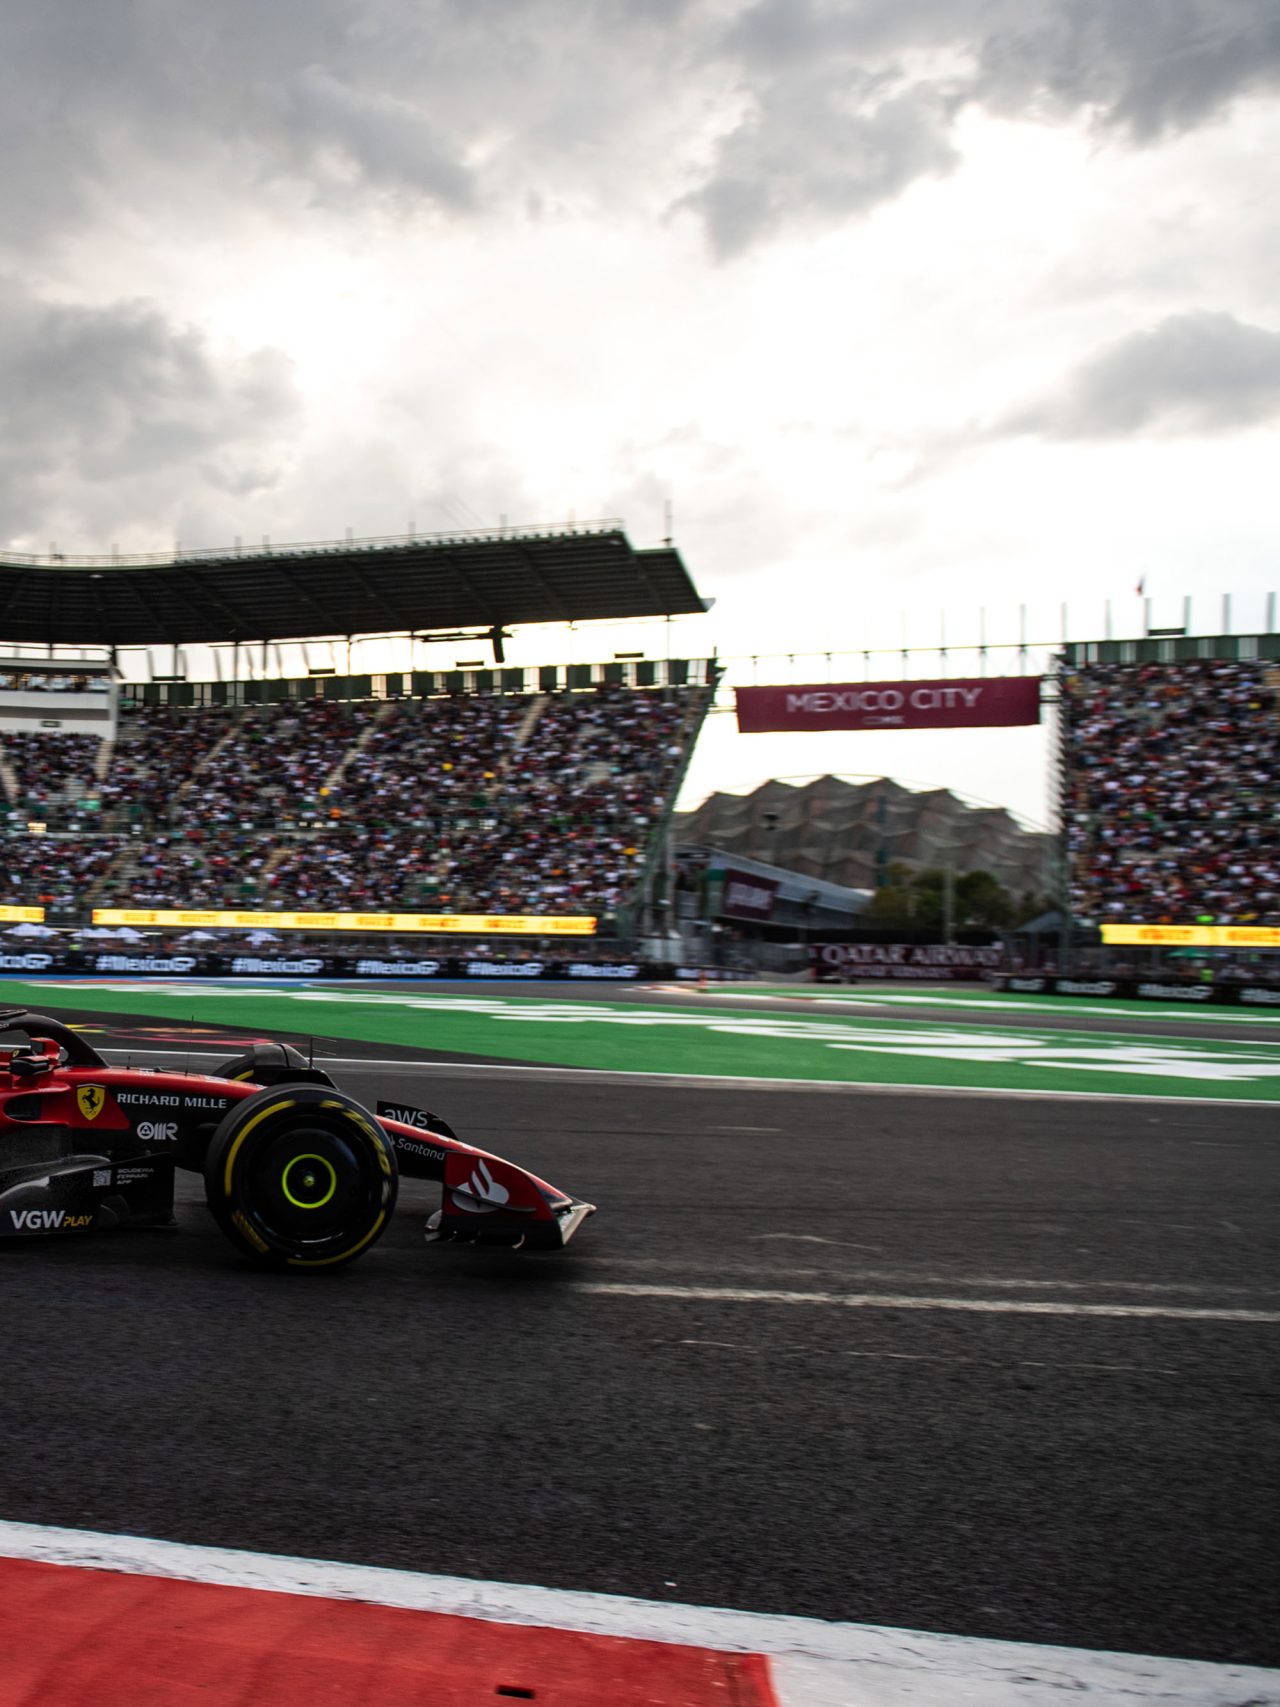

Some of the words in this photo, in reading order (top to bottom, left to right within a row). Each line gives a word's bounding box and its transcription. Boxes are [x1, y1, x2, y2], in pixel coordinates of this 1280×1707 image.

[785, 689, 905, 713] MEXICO
[909, 687, 983, 709] CITY
[117, 1092, 180, 1107] RICHARD
[184, 1096, 228, 1109] MILLE
[383, 1106, 428, 1128] aws
[396, 1136, 446, 1162] Santand
[9, 1210, 65, 1230] VGW
[63, 1214, 93, 1228] PLAY
